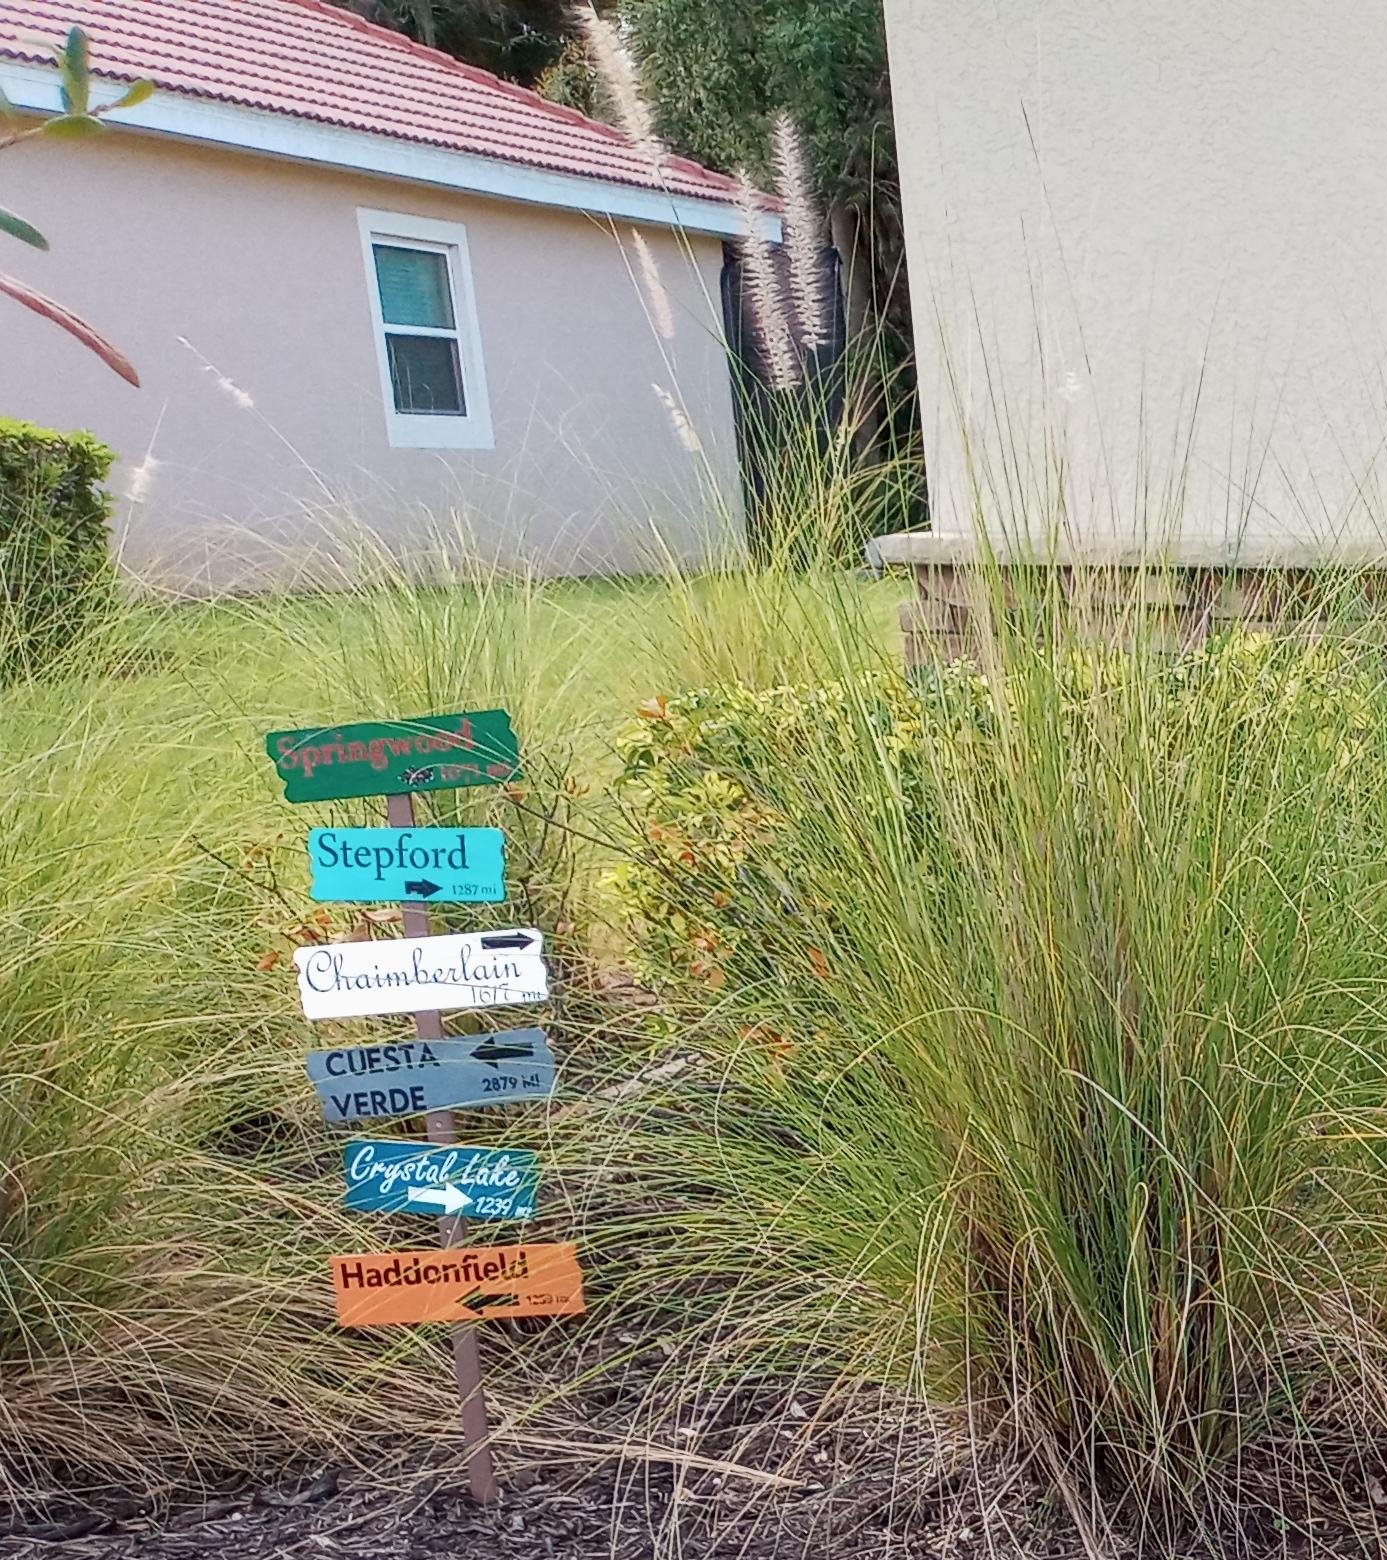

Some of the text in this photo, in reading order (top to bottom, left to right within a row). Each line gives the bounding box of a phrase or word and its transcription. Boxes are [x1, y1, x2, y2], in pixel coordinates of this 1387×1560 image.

[277, 718, 475, 777] Springwood
[318, 833, 469, 880] Stepford
[452, 883, 497, 896] 1287 mi
[306, 944, 522, 993] Chaimberlain
[325, 1042, 441, 1077] CUESTA
[331, 1085, 428, 1118] VERDE
[482, 1075, 518, 1092] 2879
[350, 1146, 521, 1194] Crystal Lake
[475, 1196, 513, 1216] 1239
[340, 1251, 529, 1289] Haddonfield
